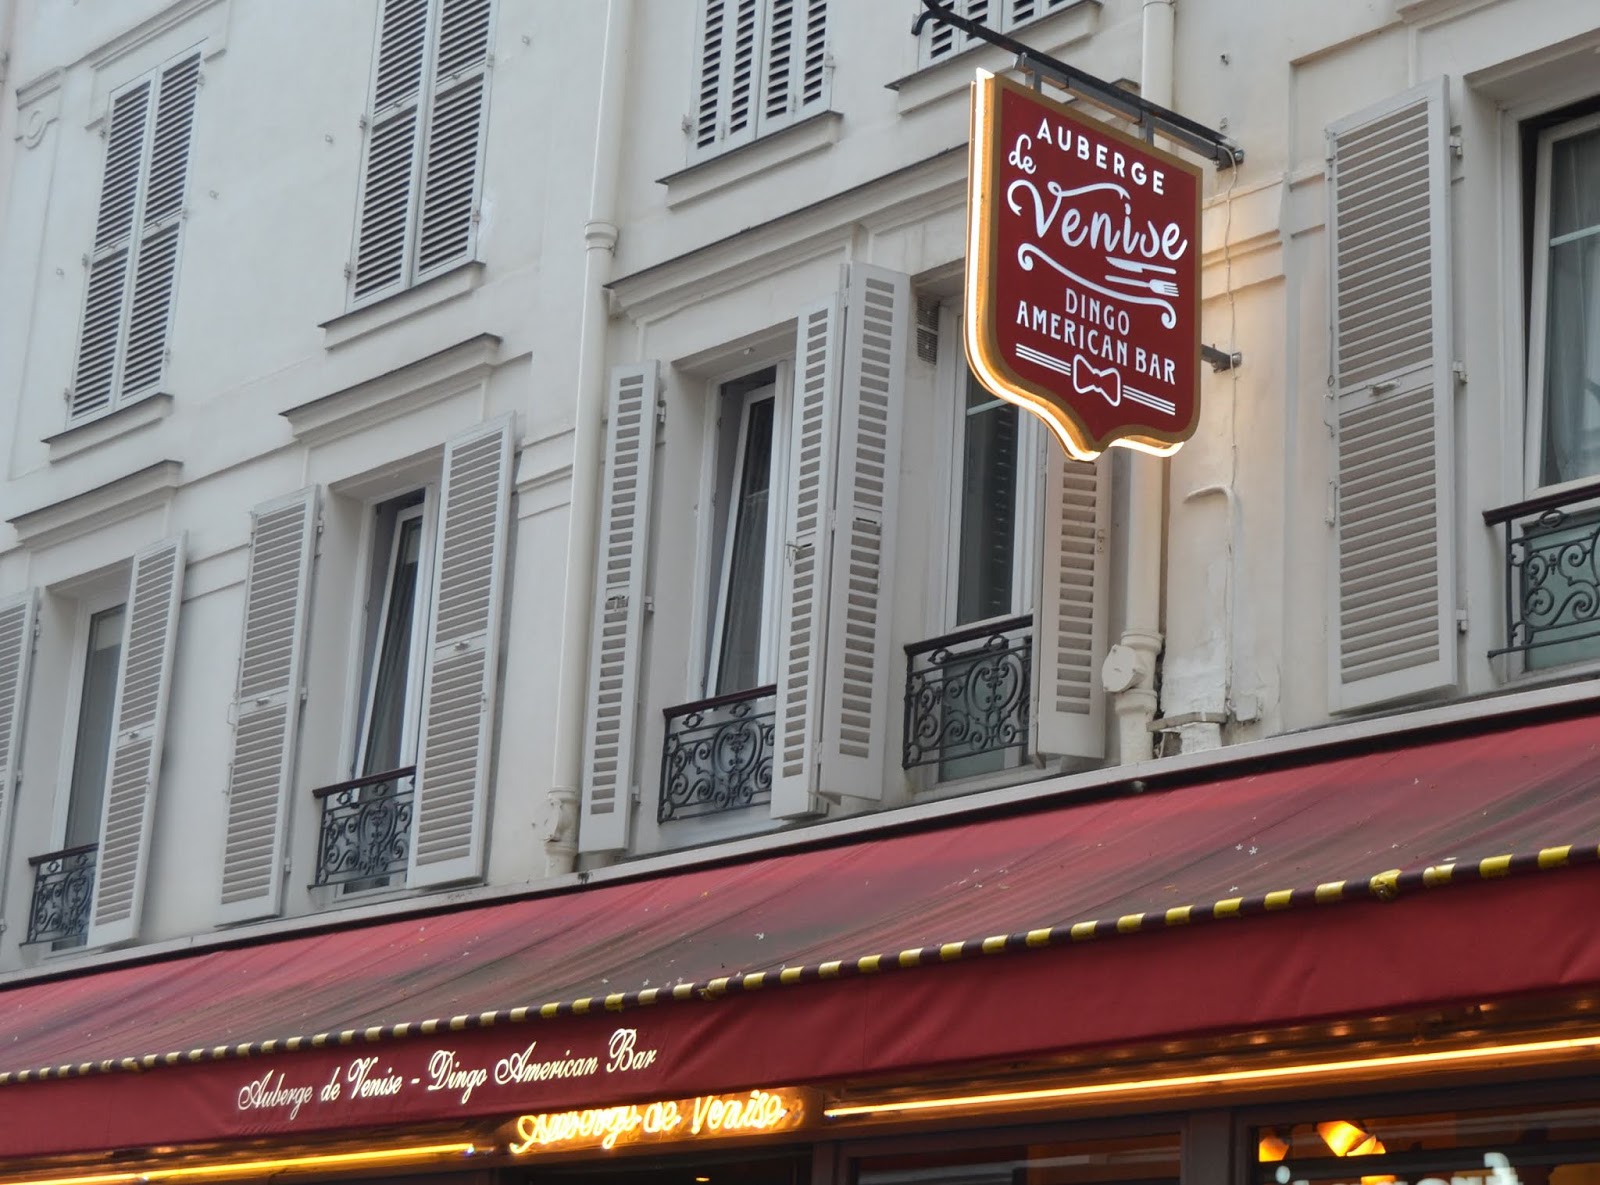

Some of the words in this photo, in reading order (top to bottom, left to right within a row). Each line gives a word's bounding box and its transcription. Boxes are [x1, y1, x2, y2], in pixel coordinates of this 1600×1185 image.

[1008, 134, 1036, 174] de
[1037, 118, 1164, 195] AUBERGE
[1007, 179, 1188, 260] Venise
[1016, 300, 1128, 366] AMERICAN
[1135, 346, 1176, 385] BAR
[1065, 288, 1130, 336] DINGO
[238, 1069, 313, 1120] Auberge
[321, 1067, 340, 1101] de
[347, 1057, 403, 1099] Venise
[428, 1050, 487, 1104] Dingo
[495, 1041, 598, 1085] American
[606, 1028, 657, 1073] Bar
